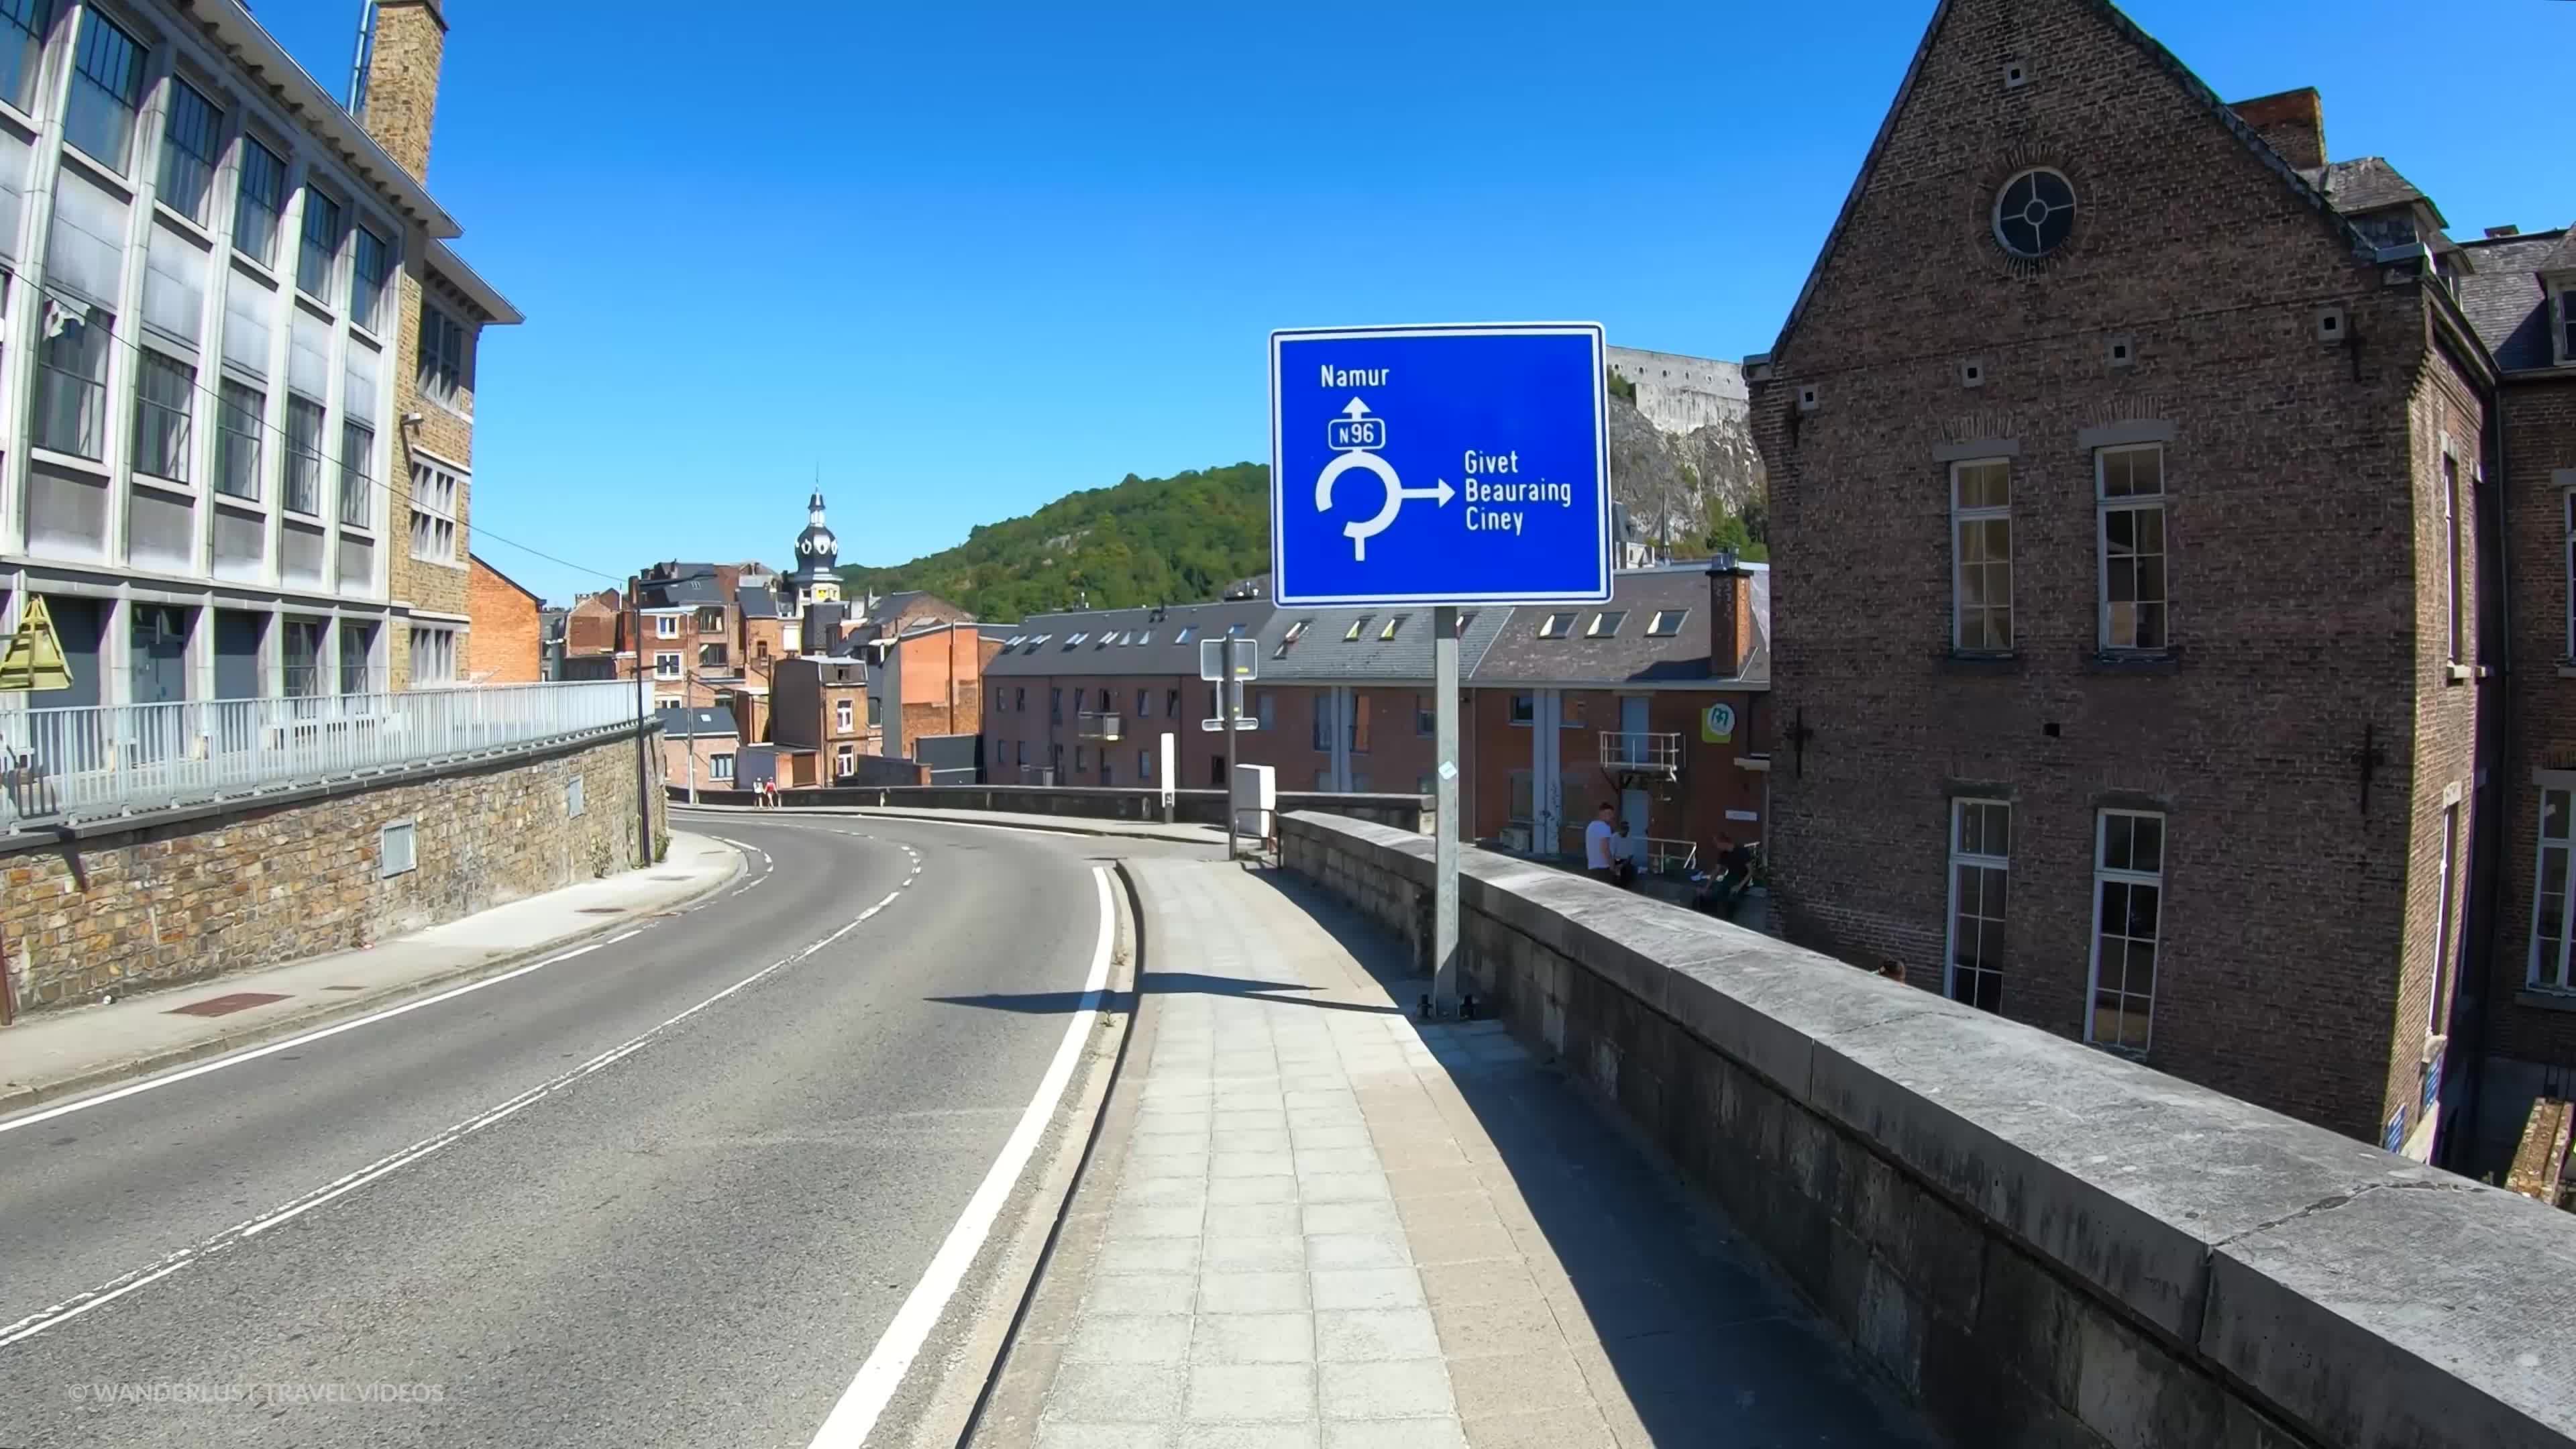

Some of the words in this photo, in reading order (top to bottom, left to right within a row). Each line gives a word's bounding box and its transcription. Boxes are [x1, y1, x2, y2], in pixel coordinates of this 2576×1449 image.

[1320, 364, 1389, 387] Namur
[1340, 423, 1374, 443] N96
[1464, 450, 1518, 474] Givet
[1465, 478, 1571, 507] Beauraing
[1466, 507, 1523, 535] Ciney
